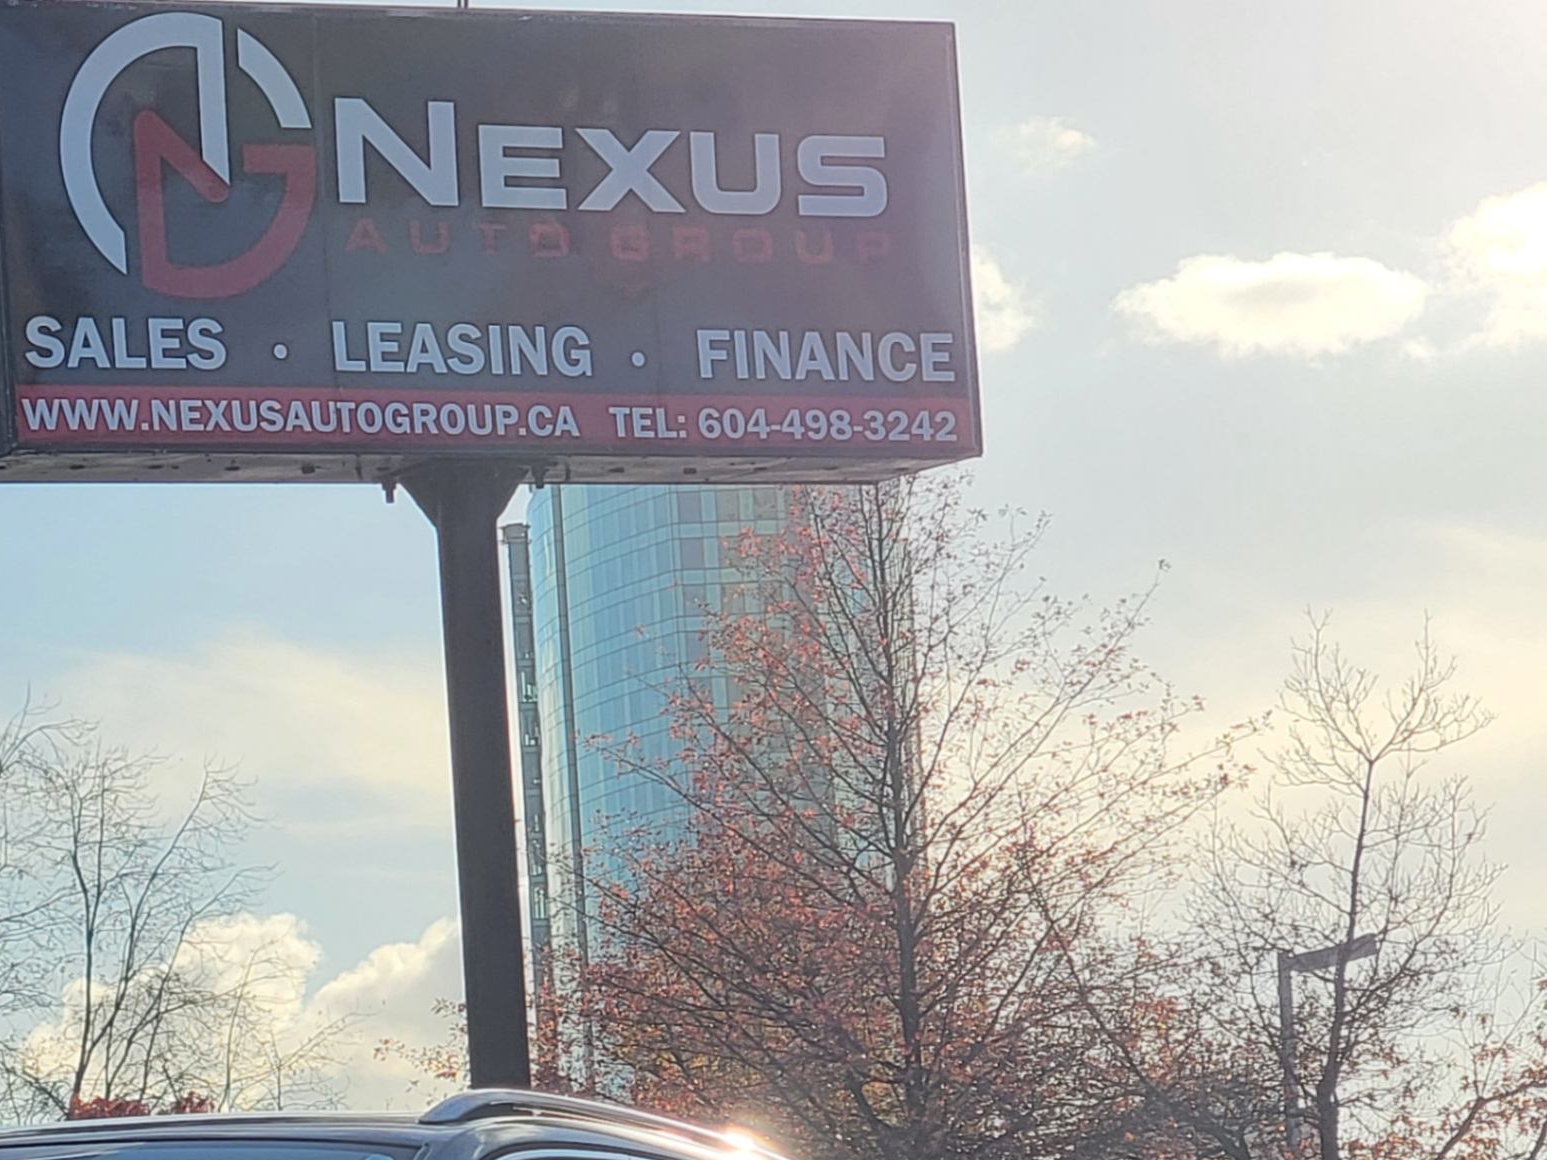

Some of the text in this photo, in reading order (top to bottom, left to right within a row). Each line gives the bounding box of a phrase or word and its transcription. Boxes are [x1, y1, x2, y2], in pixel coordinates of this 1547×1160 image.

[334, 97, 888, 218] NEXUS
[344, 217, 891, 265] AUTO GROUP
[25, 315, 956, 382] SALES LEASING FINANCE
[20, 398, 958, 442] WWW.NEXUSAUTOGROUP.CA TEL: 604-498-3242
